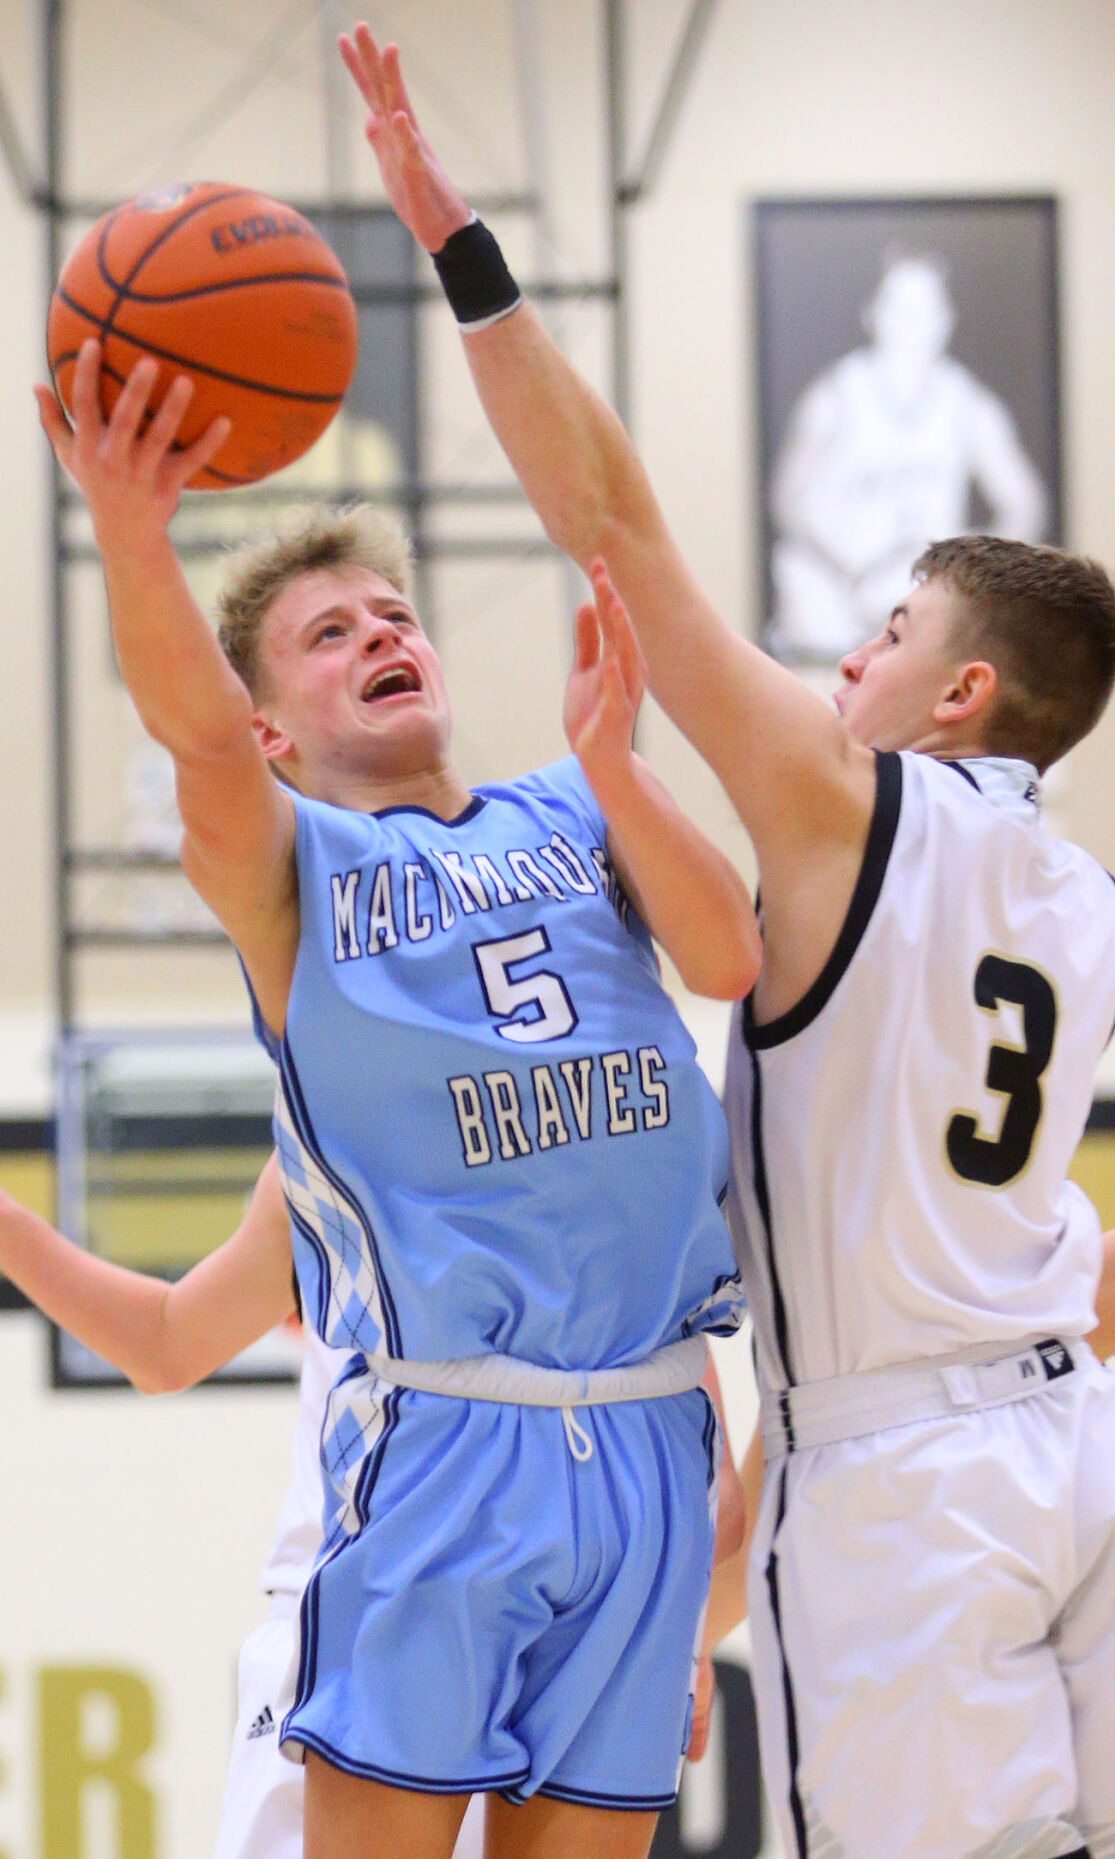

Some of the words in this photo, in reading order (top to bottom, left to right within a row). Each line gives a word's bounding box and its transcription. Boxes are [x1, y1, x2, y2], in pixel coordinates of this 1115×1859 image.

[471, 924, 579, 1044] 5
[446, 1045, 670, 1168] BRAVES
[946, 950, 1058, 1187] 3
[0, 1661, 157, 1859] R
